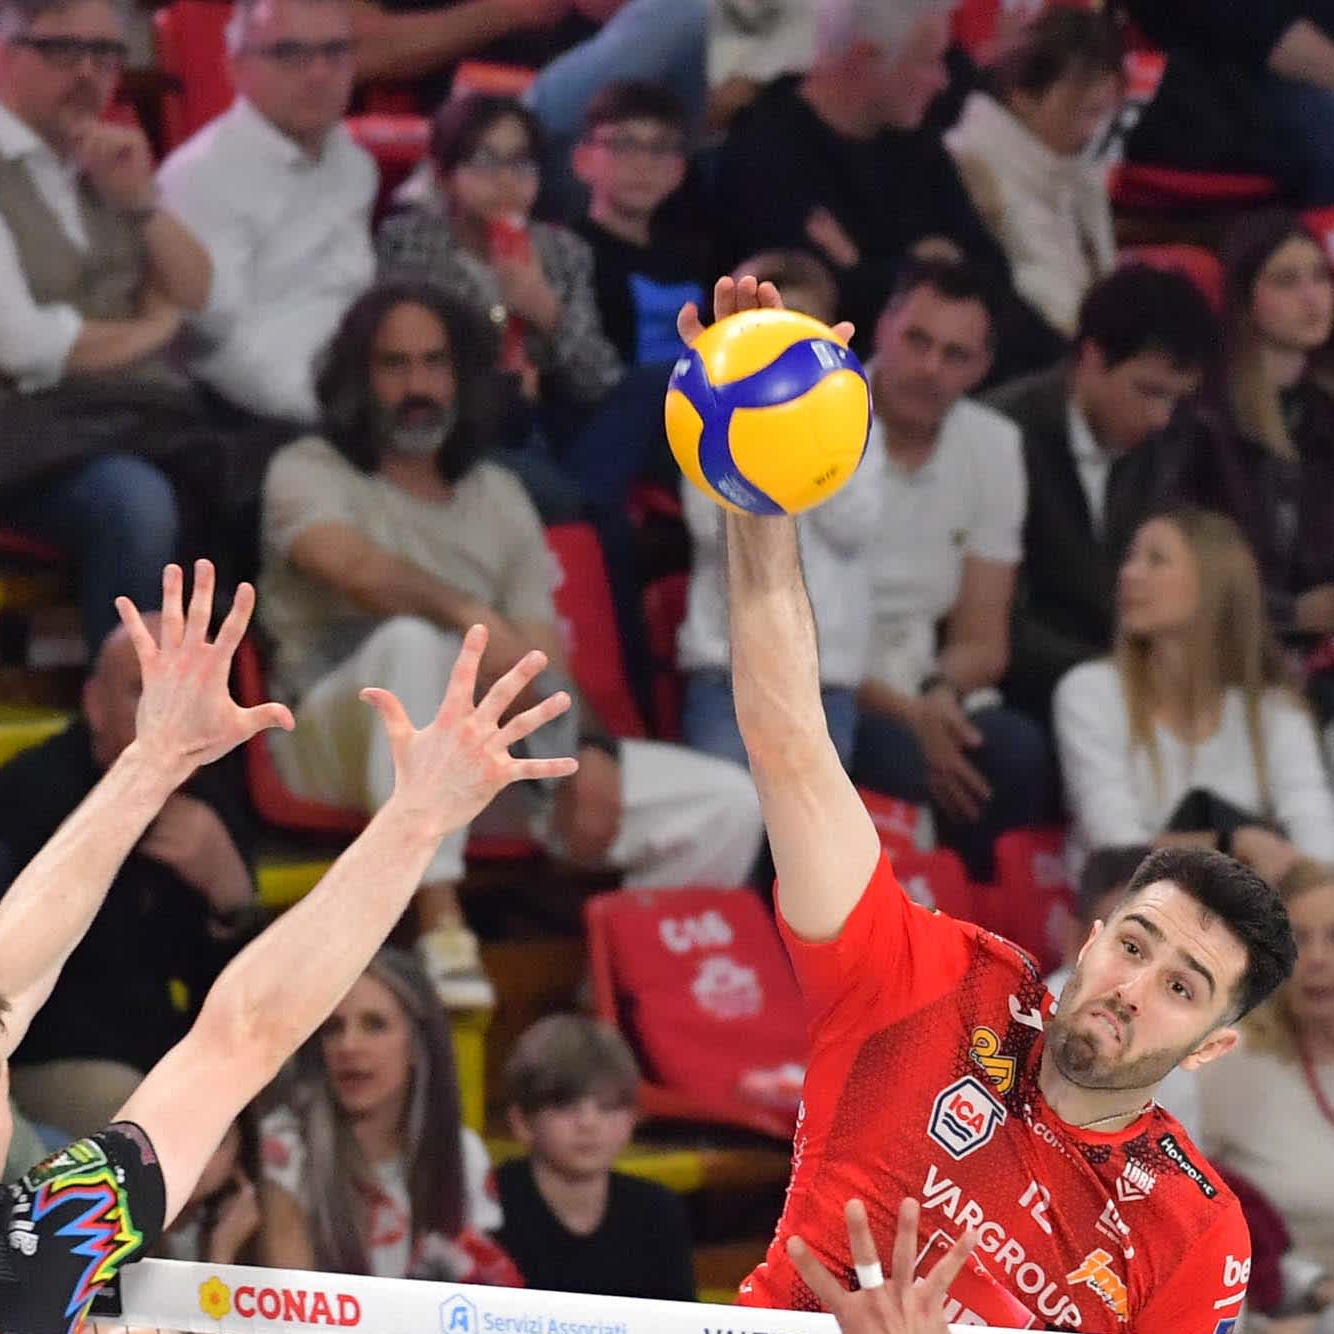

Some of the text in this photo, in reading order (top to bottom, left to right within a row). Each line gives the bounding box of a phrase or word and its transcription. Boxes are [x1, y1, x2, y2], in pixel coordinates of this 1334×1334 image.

[947, 1093, 986, 1135] ICA
[921, 1163, 1083, 1329] VARGROUP
[233, 1285, 362, 1328] CONAD
